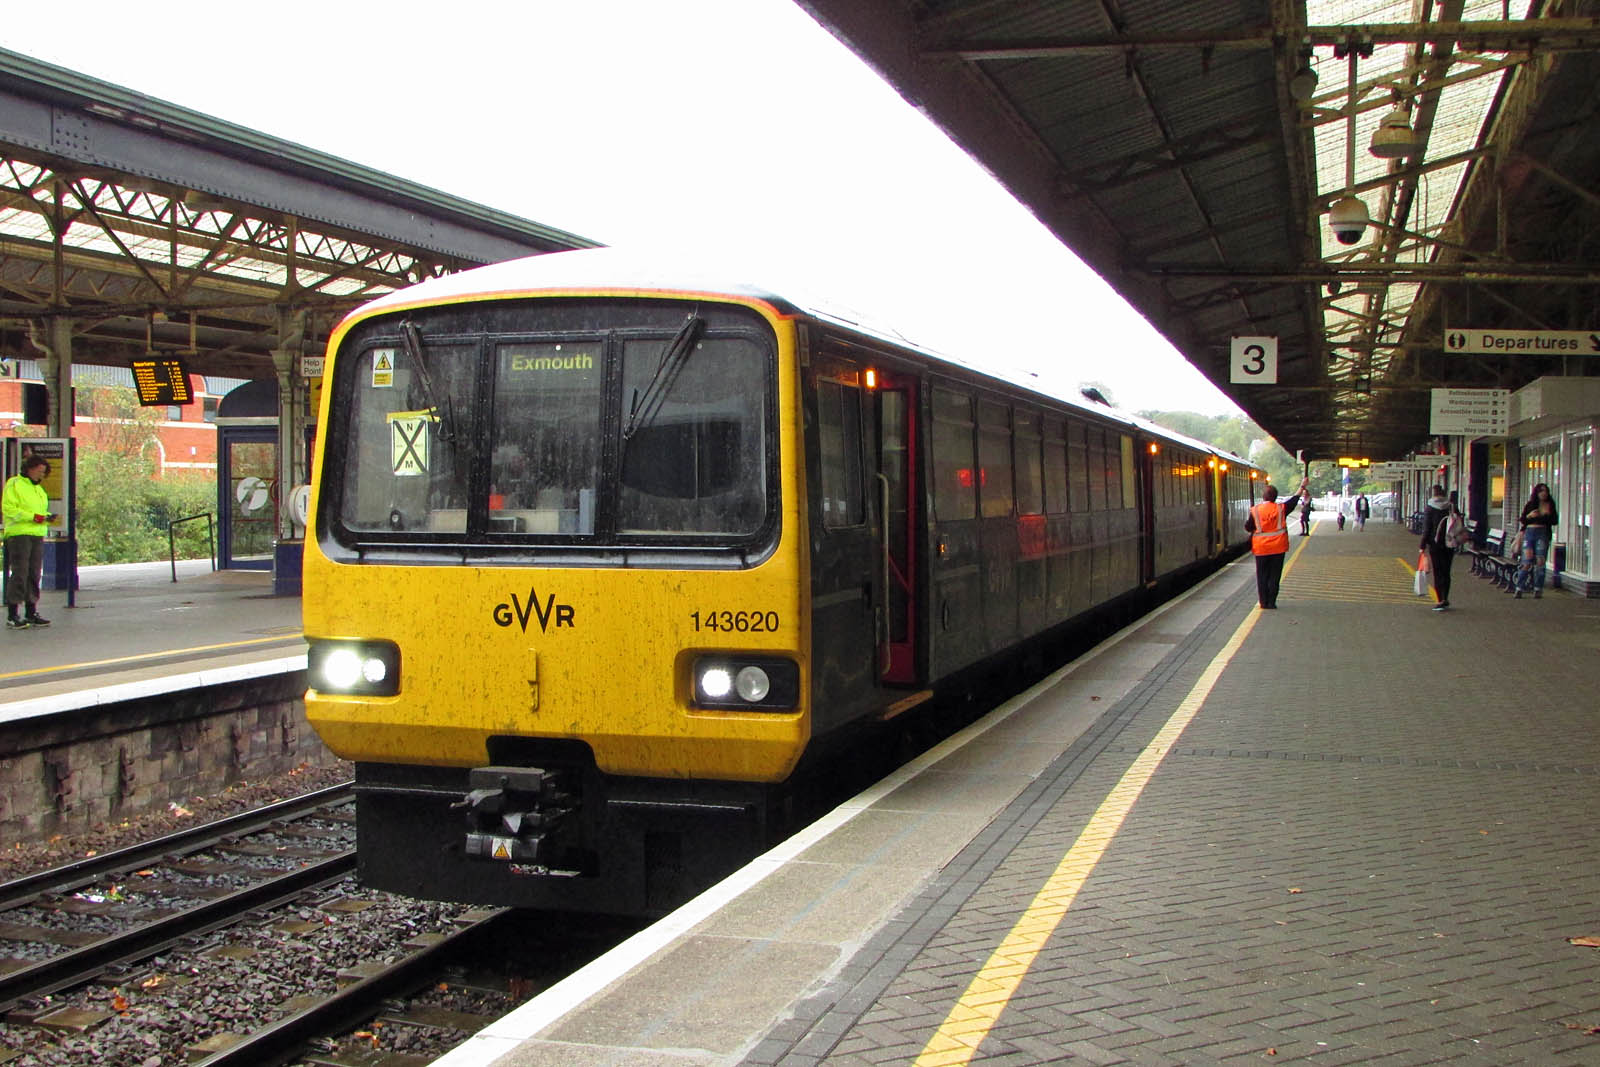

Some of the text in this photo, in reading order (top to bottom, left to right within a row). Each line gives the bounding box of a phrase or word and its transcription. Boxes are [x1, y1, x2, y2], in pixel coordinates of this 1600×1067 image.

[1482, 334, 1579, 351] Departures
[511, 353, 593, 371] Exmouth
[1242, 344, 1265, 375] 3
[406, 423, 413, 431] N
[405, 460, 413, 469] M
[493, 587, 575, 634] GWR
[690, 610, 780, 633] 143620
